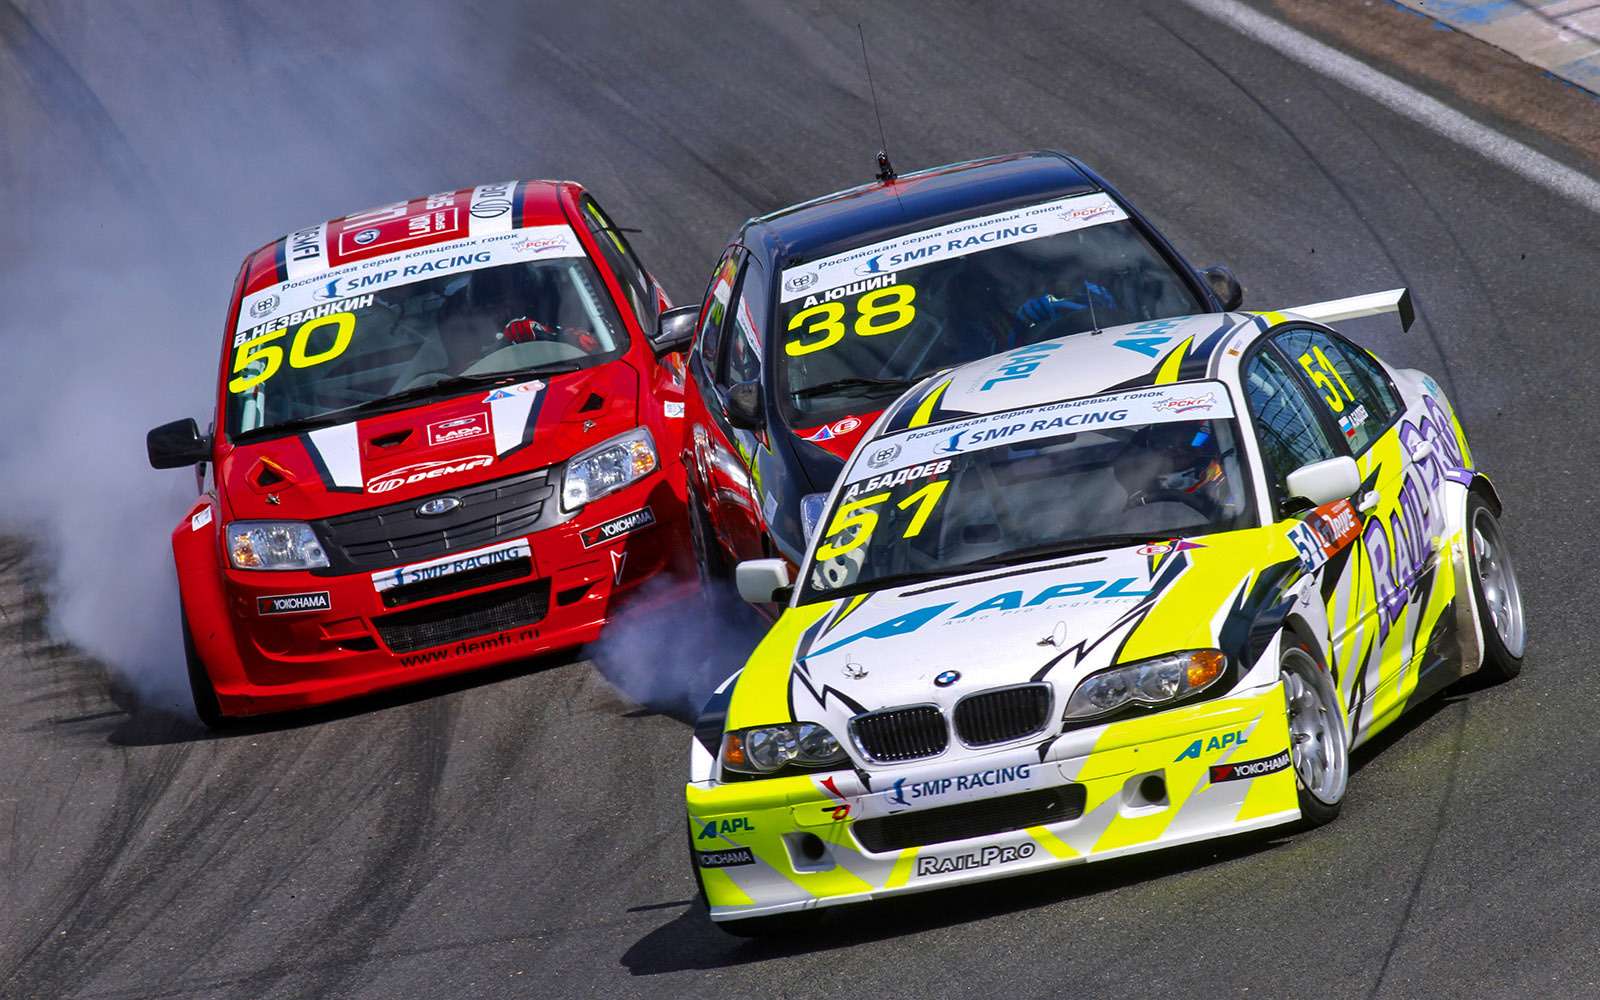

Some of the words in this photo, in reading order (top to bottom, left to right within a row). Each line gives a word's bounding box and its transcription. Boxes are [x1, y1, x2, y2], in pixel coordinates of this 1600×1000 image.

[818, 243, 898, 270] Российская
[901, 231, 943, 247] серия
[946, 214, 1021, 235] кольцевых
[1025, 204, 1064, 217] гонок
[889, 244, 941, 267] SMP
[947, 224, 1039, 252] RACING
[281, 266, 358, 291] Российская
[362, 256, 402, 269] серия
[405, 240, 477, 258] кольцевых
[482, 234, 519, 245] гонок
[346, 268, 401, 292] SMP
[402, 251, 492, 277] RACING
[803, 273, 897, 308] А.ЮШИН
[233, 294, 374, 349] В.НЕЗВАНКИН
[784, 283, 917, 357] 38
[228, 311, 356, 394] 50
[1298, 345, 1355, 413] 51
[905, 417, 988, 442] Российская
[991, 407, 1034, 424] серия
[1038, 394, 1119, 414] кольцевых
[1121, 389, 1165, 401] гонок
[968, 423, 1025, 446] SMP
[1028, 409, 1129, 433] RACING
[406, 458, 493, 484] DEMFI
[846, 460, 952, 498] А.БАДОЕВ
[601, 511, 652, 537] YOKOHAMA
[815, 480, 950, 561] 51
[411, 564, 449, 584] SMP
[453, 546, 519, 573] RACING
[1287, 522, 1324, 571] 51
[273, 595, 327, 610] YOKOHAMA
[950, 576, 1154, 619] APL
[1206, 730, 1248, 752] APL
[911, 780, 952, 798] SMP
[956, 765, 1031, 792] RACING
[1233, 753, 1290, 777] YOKOHAMA
[720, 817, 755, 834] APL
